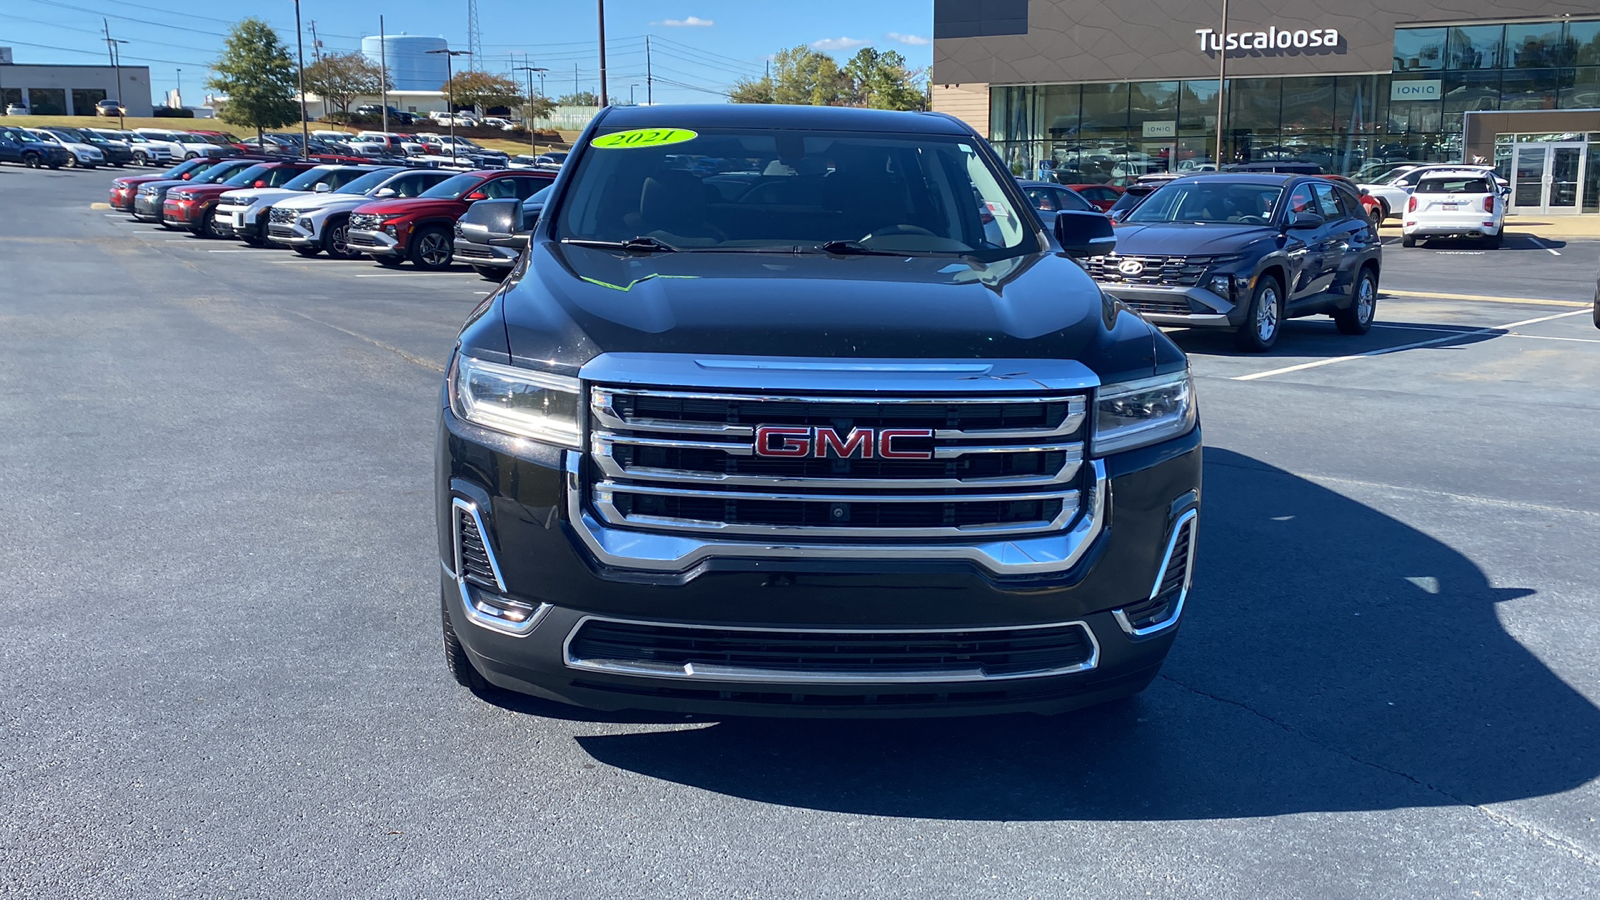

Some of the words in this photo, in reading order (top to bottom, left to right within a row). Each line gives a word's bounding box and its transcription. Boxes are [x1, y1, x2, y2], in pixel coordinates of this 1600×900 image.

[1195, 26, 1338, 51] Tuscaloosa
[1397, 85, 1435, 94] IONIQ
[605, 130, 675, 146] 2021
[756, 426, 933, 459] GMC
